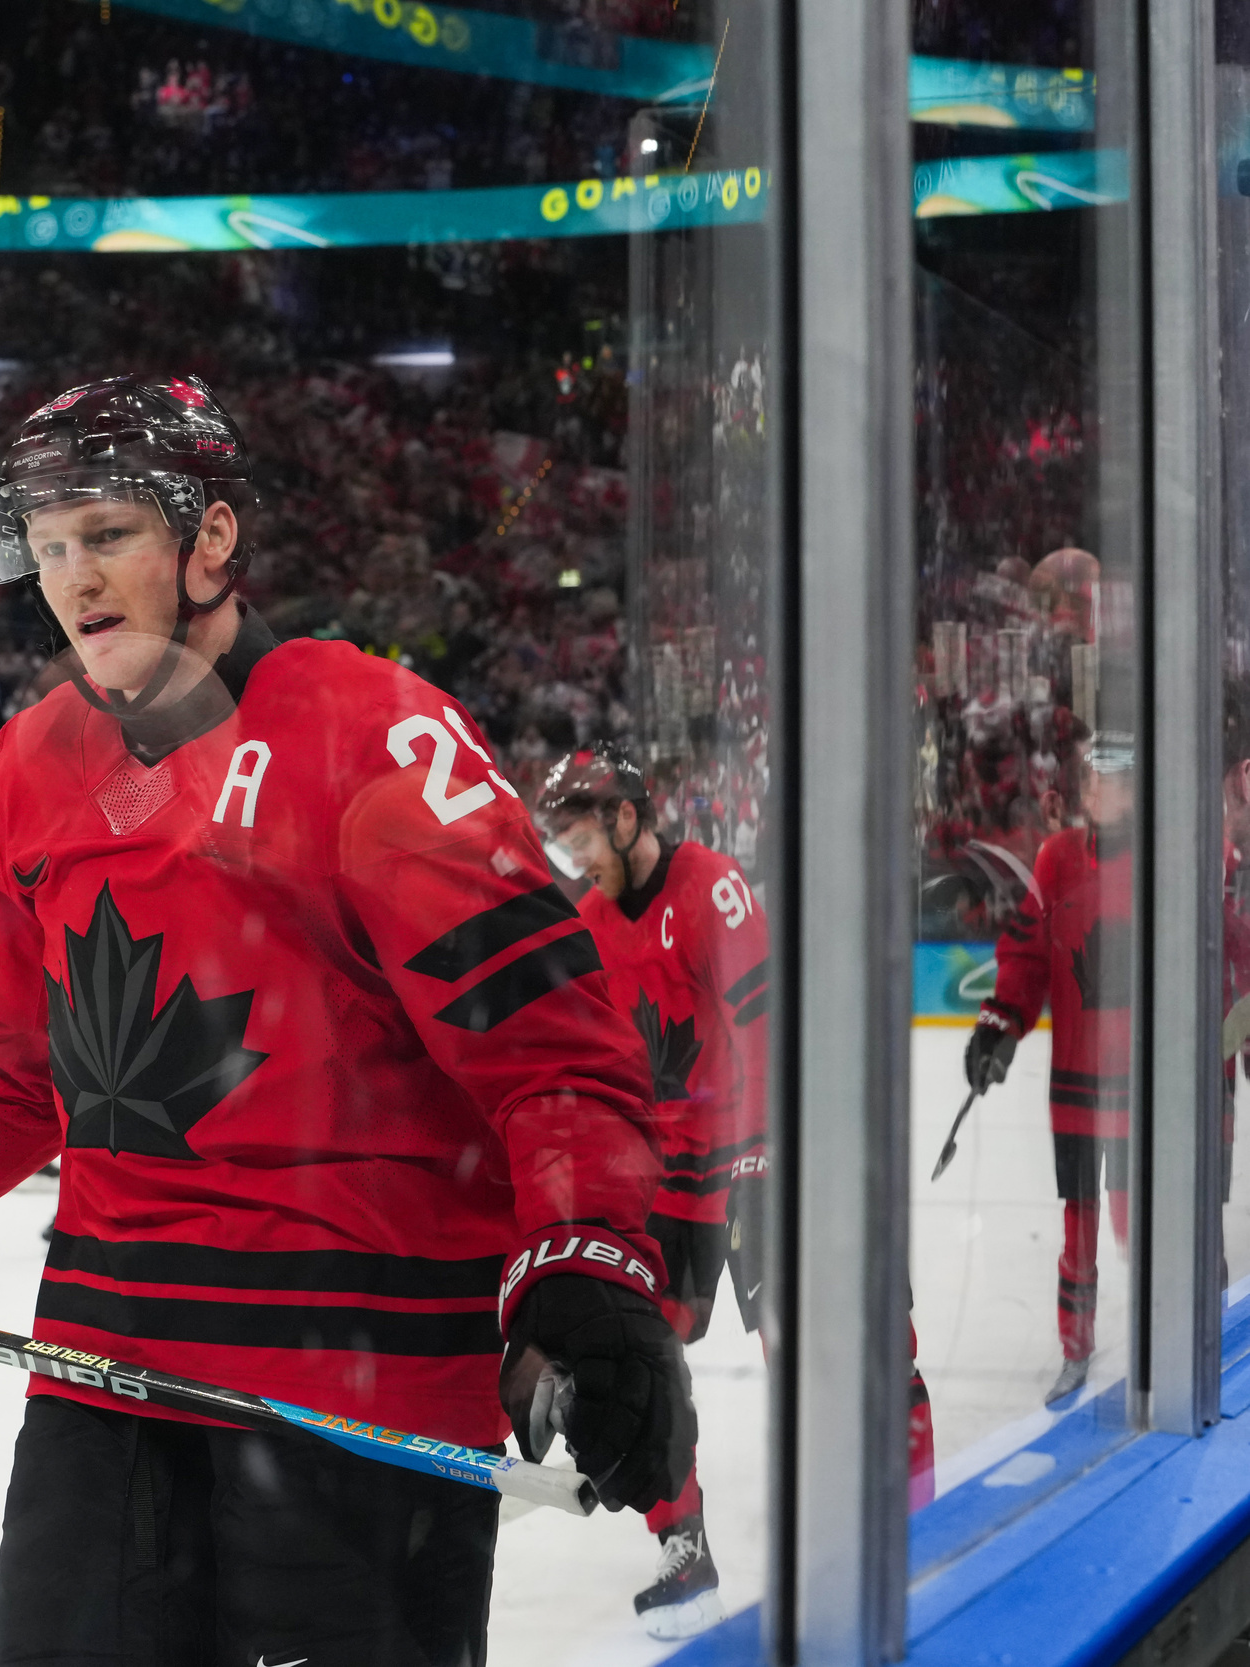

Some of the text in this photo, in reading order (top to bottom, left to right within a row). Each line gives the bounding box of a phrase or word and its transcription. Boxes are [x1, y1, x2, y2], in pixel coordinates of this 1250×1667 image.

[12, 450, 63, 469] MILANO CORTINA
[196, 440, 234, 454] CCM
[27, 460, 40, 469] 2026
[212, 740, 272, 827] A
[661, 905, 674, 950] C
[301, 1409, 410, 1446] SYNC
